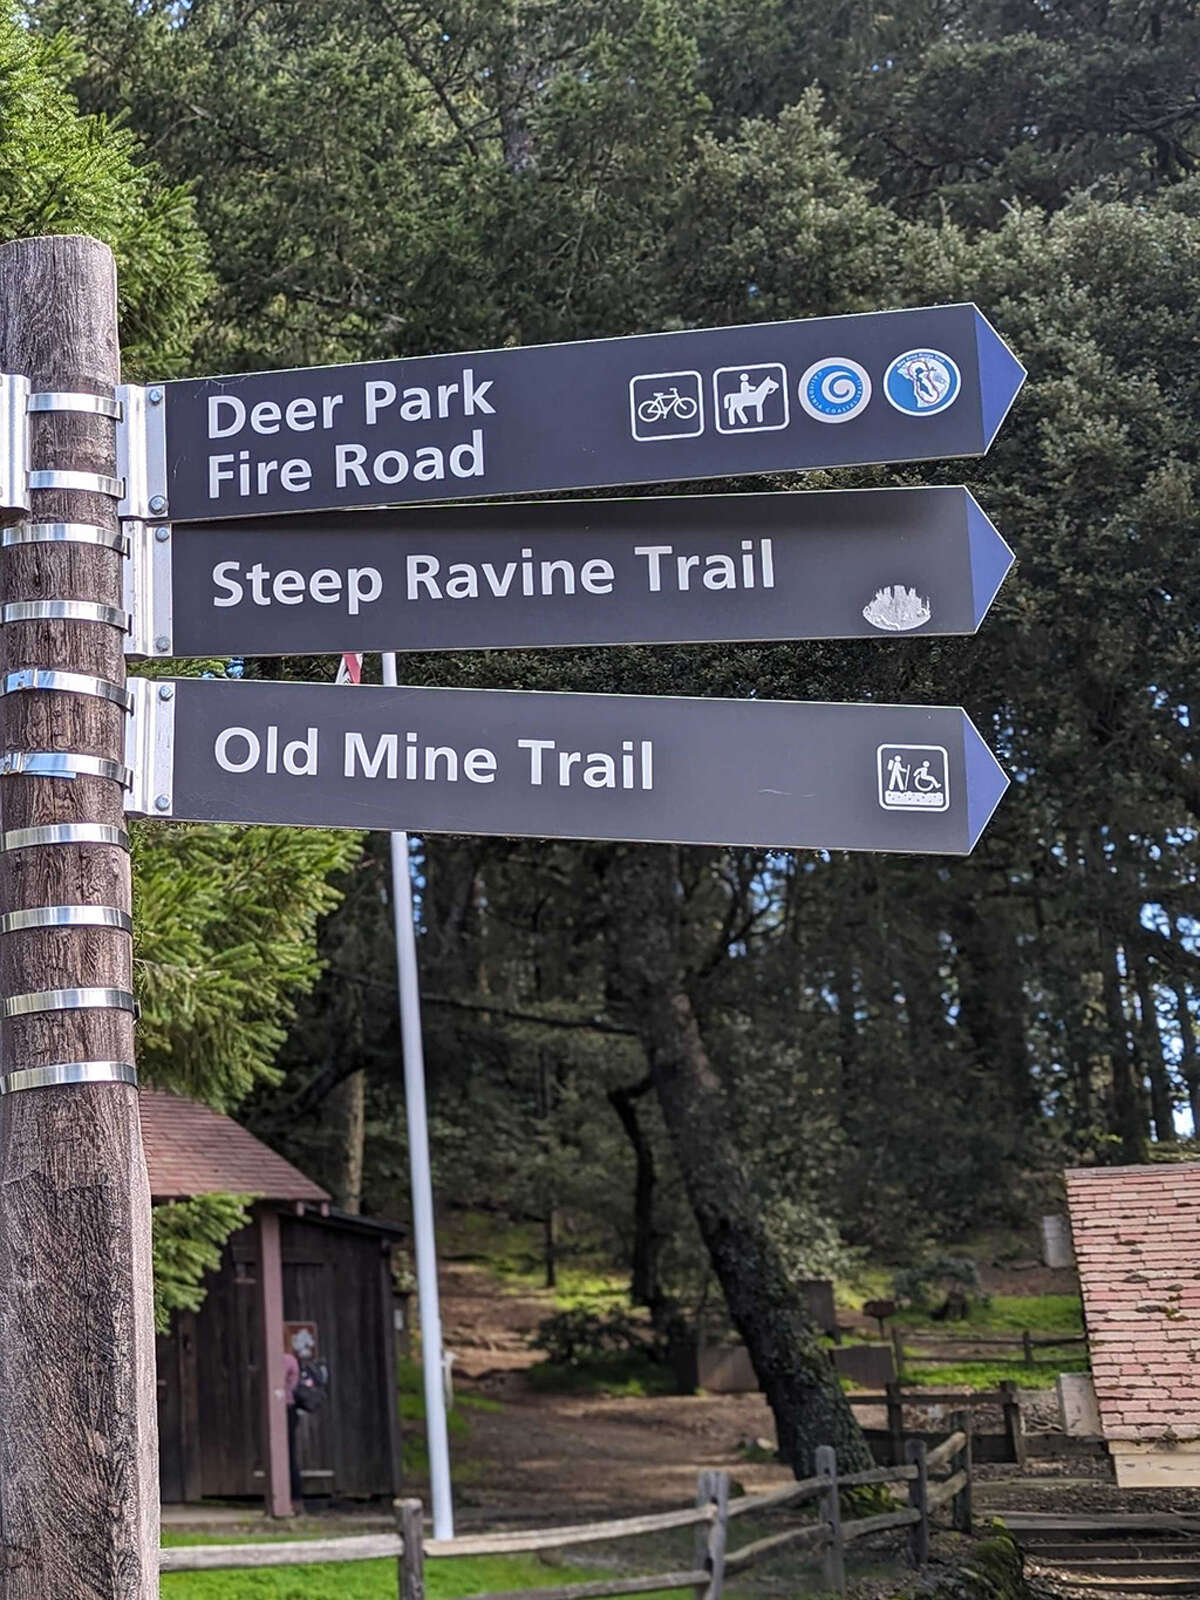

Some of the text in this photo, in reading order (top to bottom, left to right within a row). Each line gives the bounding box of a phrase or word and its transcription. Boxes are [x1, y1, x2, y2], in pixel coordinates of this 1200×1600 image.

[209, 369, 496, 438] Deer Park
[209, 429, 484, 498] Fire Road
[213, 539, 774, 614] Steep Ravine Trail
[215, 726, 652, 789] Old Mine Trail
